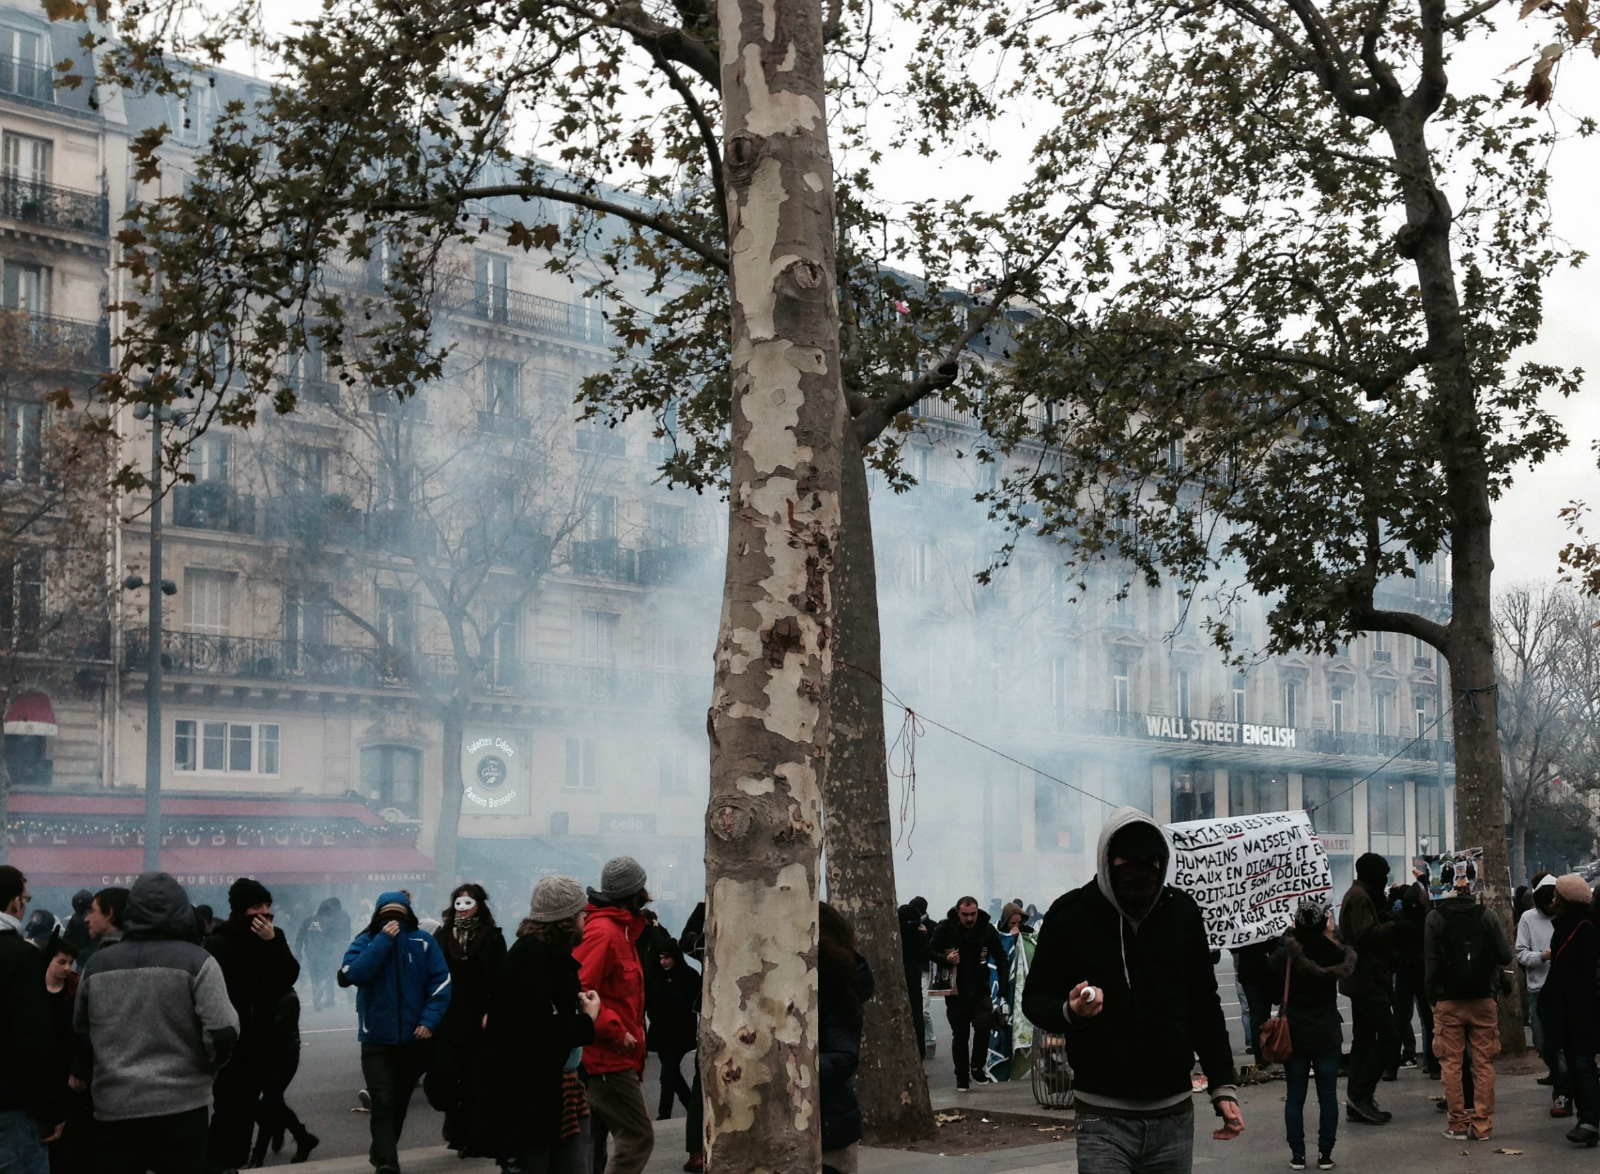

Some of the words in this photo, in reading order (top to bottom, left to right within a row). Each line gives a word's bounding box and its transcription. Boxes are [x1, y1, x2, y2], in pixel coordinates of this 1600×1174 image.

[1146, 715, 1188, 739] WALL
[1190, 720, 1239, 743] STREET
[1242, 724, 1296, 748] ENGLISH
[466, 738, 493, 754] Galettes
[495, 737, 514, 757] Crêpes
[464, 786, 487, 807] Paninis
[488, 789, 517, 808] Boissons
[1240, 817, 1263, 831] LES
[1176, 846, 1238, 870] HUMAINS
[1243, 825, 1301, 855] NAISSENT
[102, 875, 139, 885] CAF
[367, 873, 426, 881] RESTAURANT
[1175, 869, 1222, 886] ÉGAUX
[1226, 866, 1242, 880] EN
[1246, 847, 1293, 876] DIGNITÉ
[1296, 845, 1309, 860] ET
[1227, 881, 1246, 898] ILS
[1250, 873, 1271, 890] SONT
[1276, 860, 1317, 880] DOUÉS
[1233, 898, 1245, 913] DE
[1249, 872, 1330, 908] CONSCIENCE
[1241, 908, 1266, 926] AGIR
[1269, 899, 1289, 914] LES
[1232, 931, 1251, 944] LES
